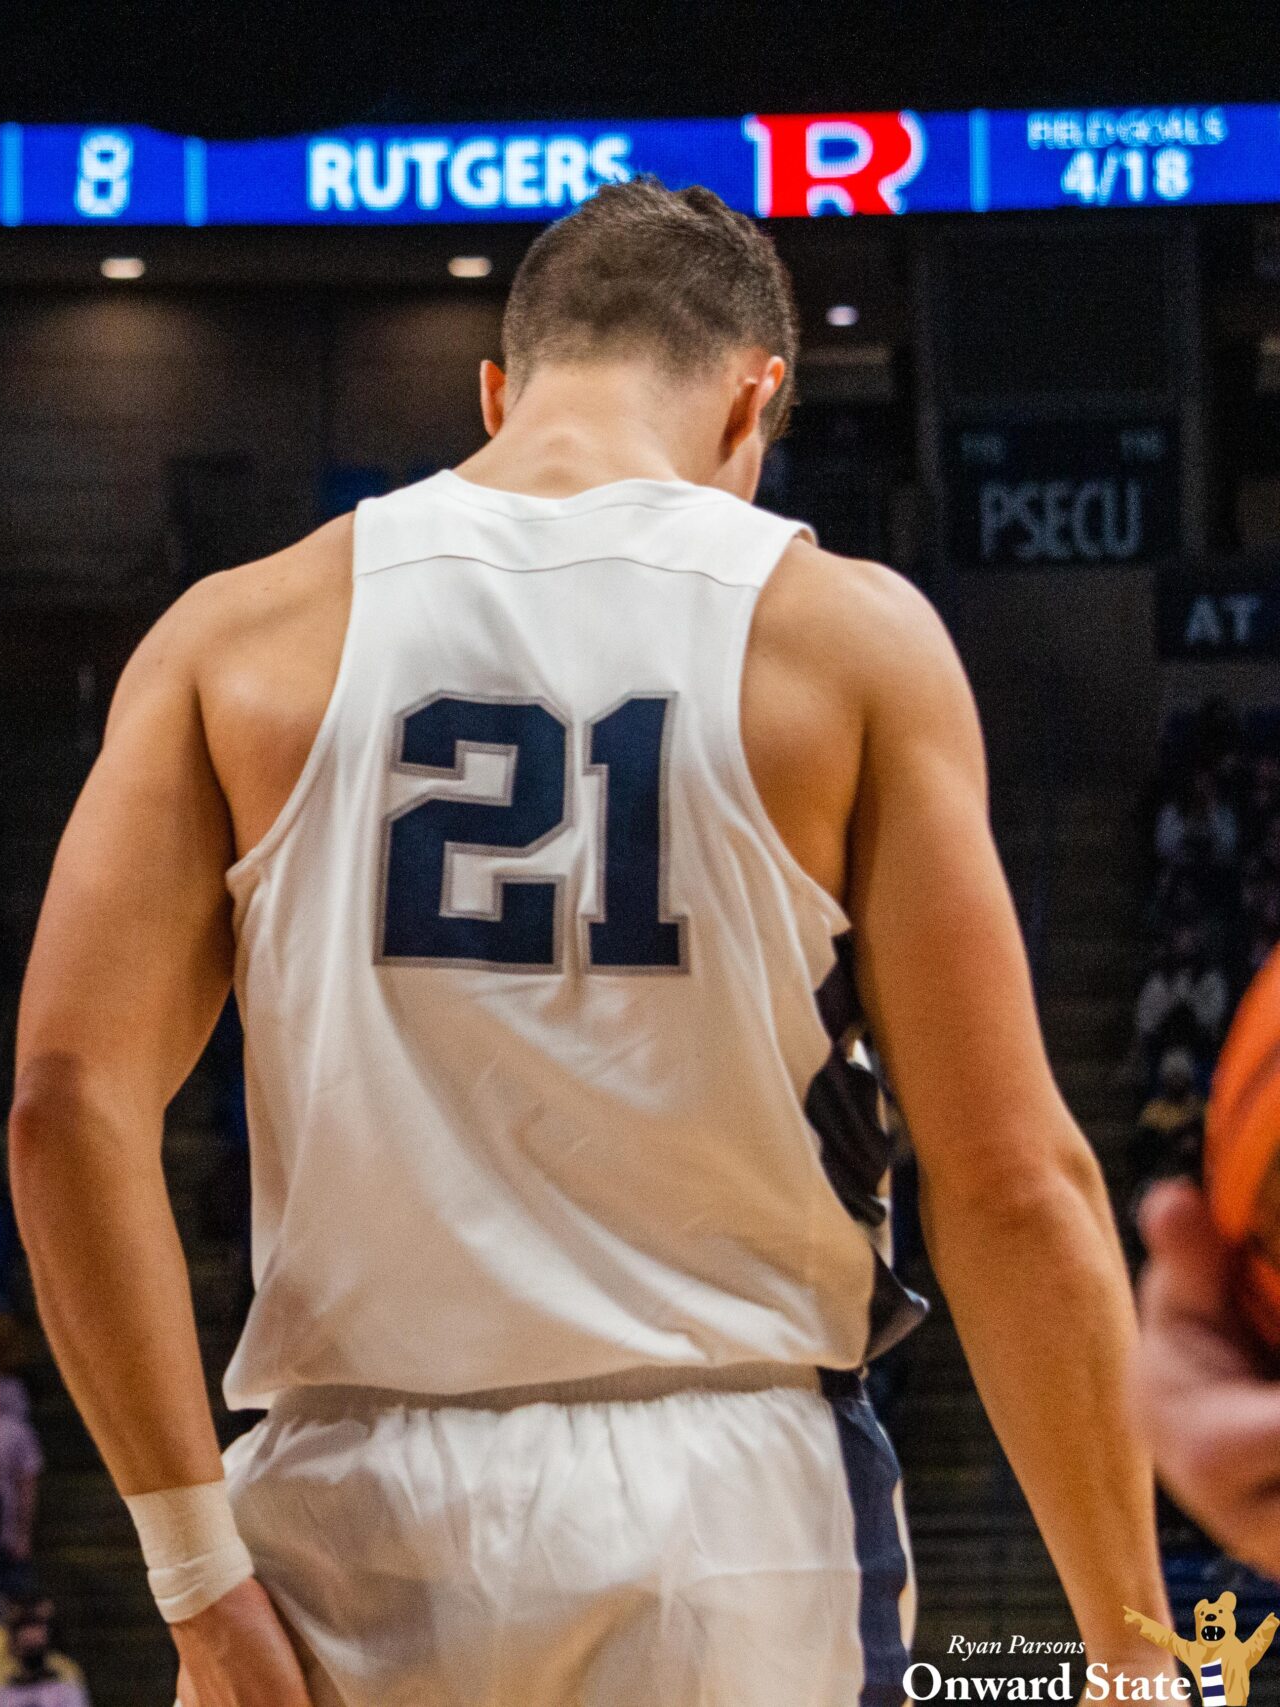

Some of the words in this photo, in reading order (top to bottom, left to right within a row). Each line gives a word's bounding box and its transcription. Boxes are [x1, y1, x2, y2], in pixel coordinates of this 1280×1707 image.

[73, 128, 133, 217] 8
[306, 131, 634, 212] RUTGERS
[1060, 146, 1194, 206] 4/18
[978, 479, 1142, 560] PSECU
[1184, 594, 1261, 645] AT
[373, 689, 690, 976] 21
